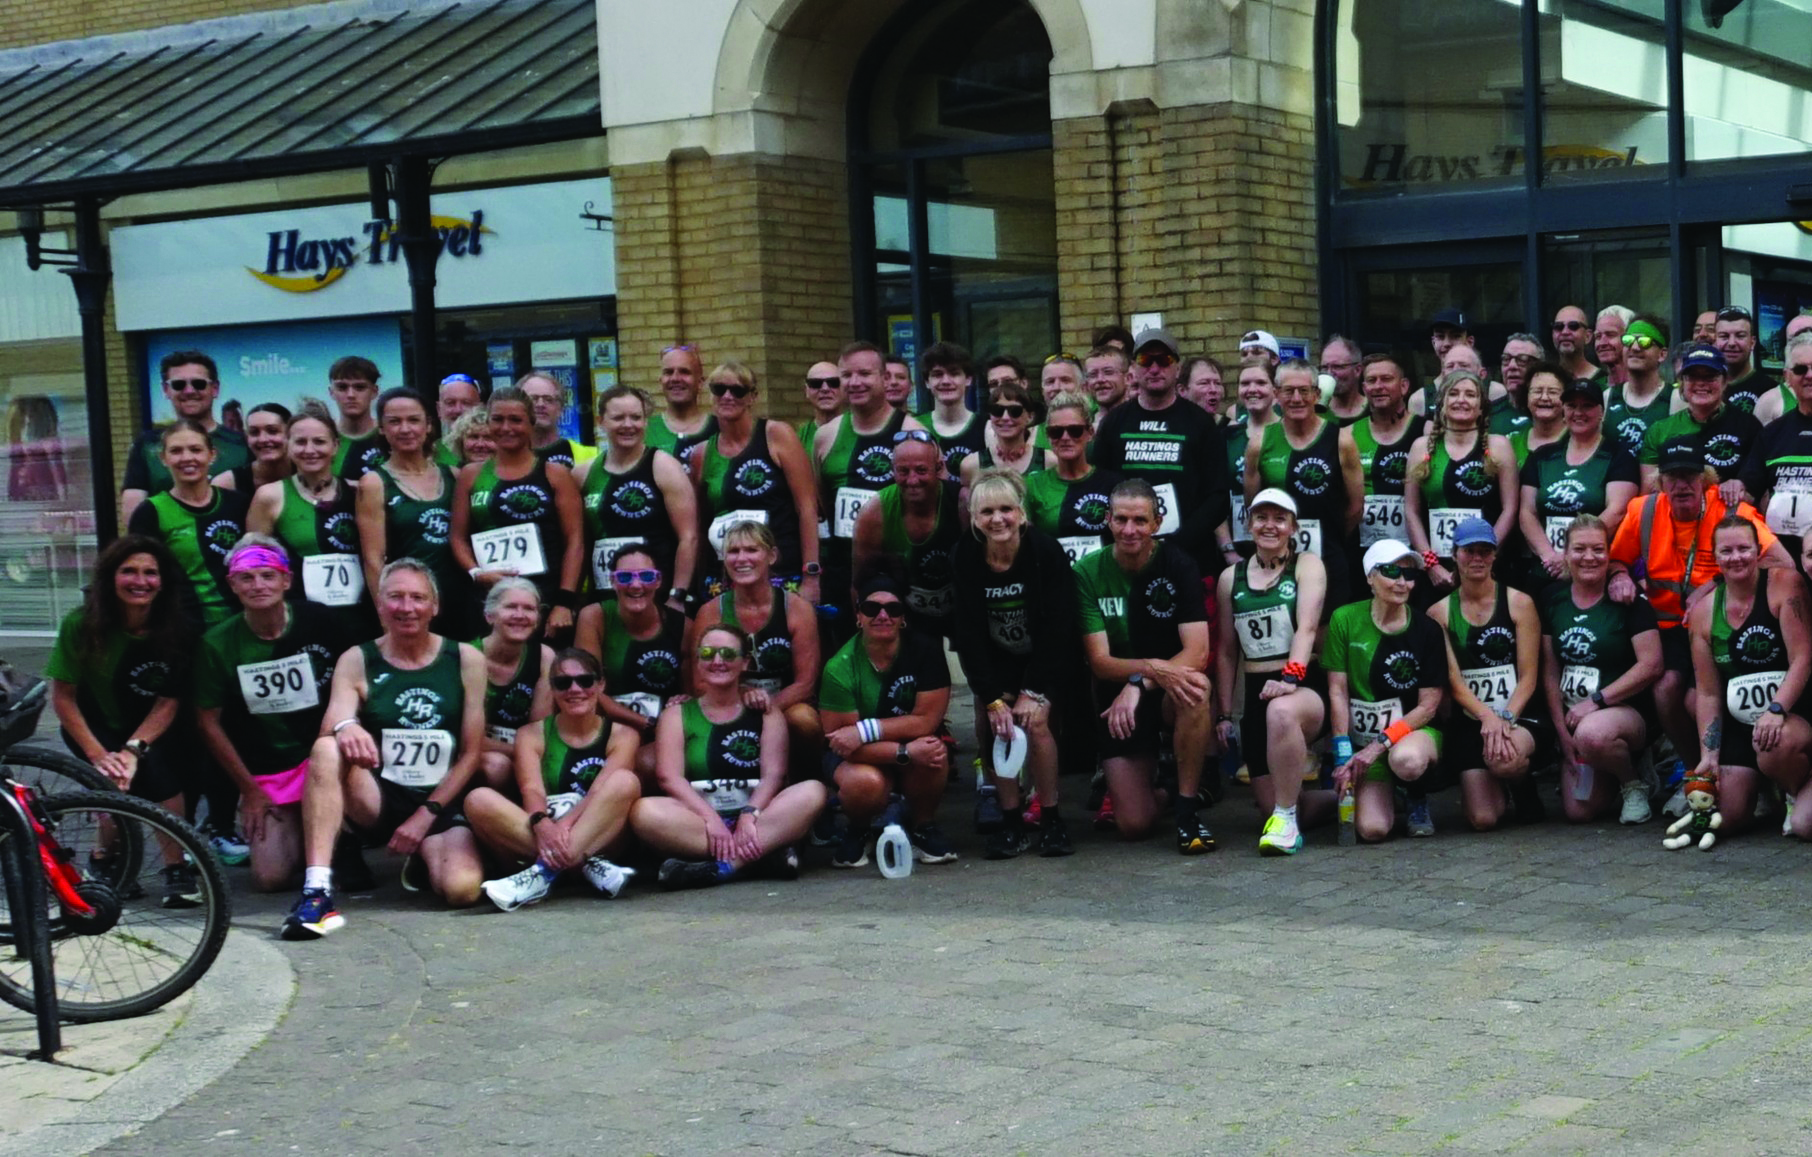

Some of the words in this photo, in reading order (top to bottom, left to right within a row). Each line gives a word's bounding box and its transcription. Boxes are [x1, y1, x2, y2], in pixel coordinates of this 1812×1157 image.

[1488, 144, 1638, 177] Tavel
[263, 228, 355, 282] Hays
[363, 208, 484, 265] Trvel
[1139, 420, 1168, 432] WILL
[857, 445, 894, 463] HASTING
[1125, 441, 1180, 453] HASTINGS
[1125, 451, 1179, 463] RUNNERS
[1550, 485, 1579, 503] HR
[1365, 505, 1402, 527] 546
[1791, 496, 1798, 519] 1
[483, 536, 528, 565] 279
[322, 564, 350, 588] 70
[984, 582, 1024, 599] TRACY
[1098, 596, 1124, 618] KEV
[1249, 616, 1273, 641] 87
[1559, 626, 1597, 643] HASTINGS
[1736, 625, 1776, 650] HASTINGS
[1566, 635, 1590, 655] HR
[253, 668, 304, 699] 390
[1469, 677, 1509, 704] 224
[1561, 678, 1588, 699] 46
[395, 687, 440, 705] HASTINGS
[1736, 682, 1778, 711] 200
[401, 698, 434, 719] HR
[1354, 711, 1392, 733] 327
[392, 742, 440, 766] 270
